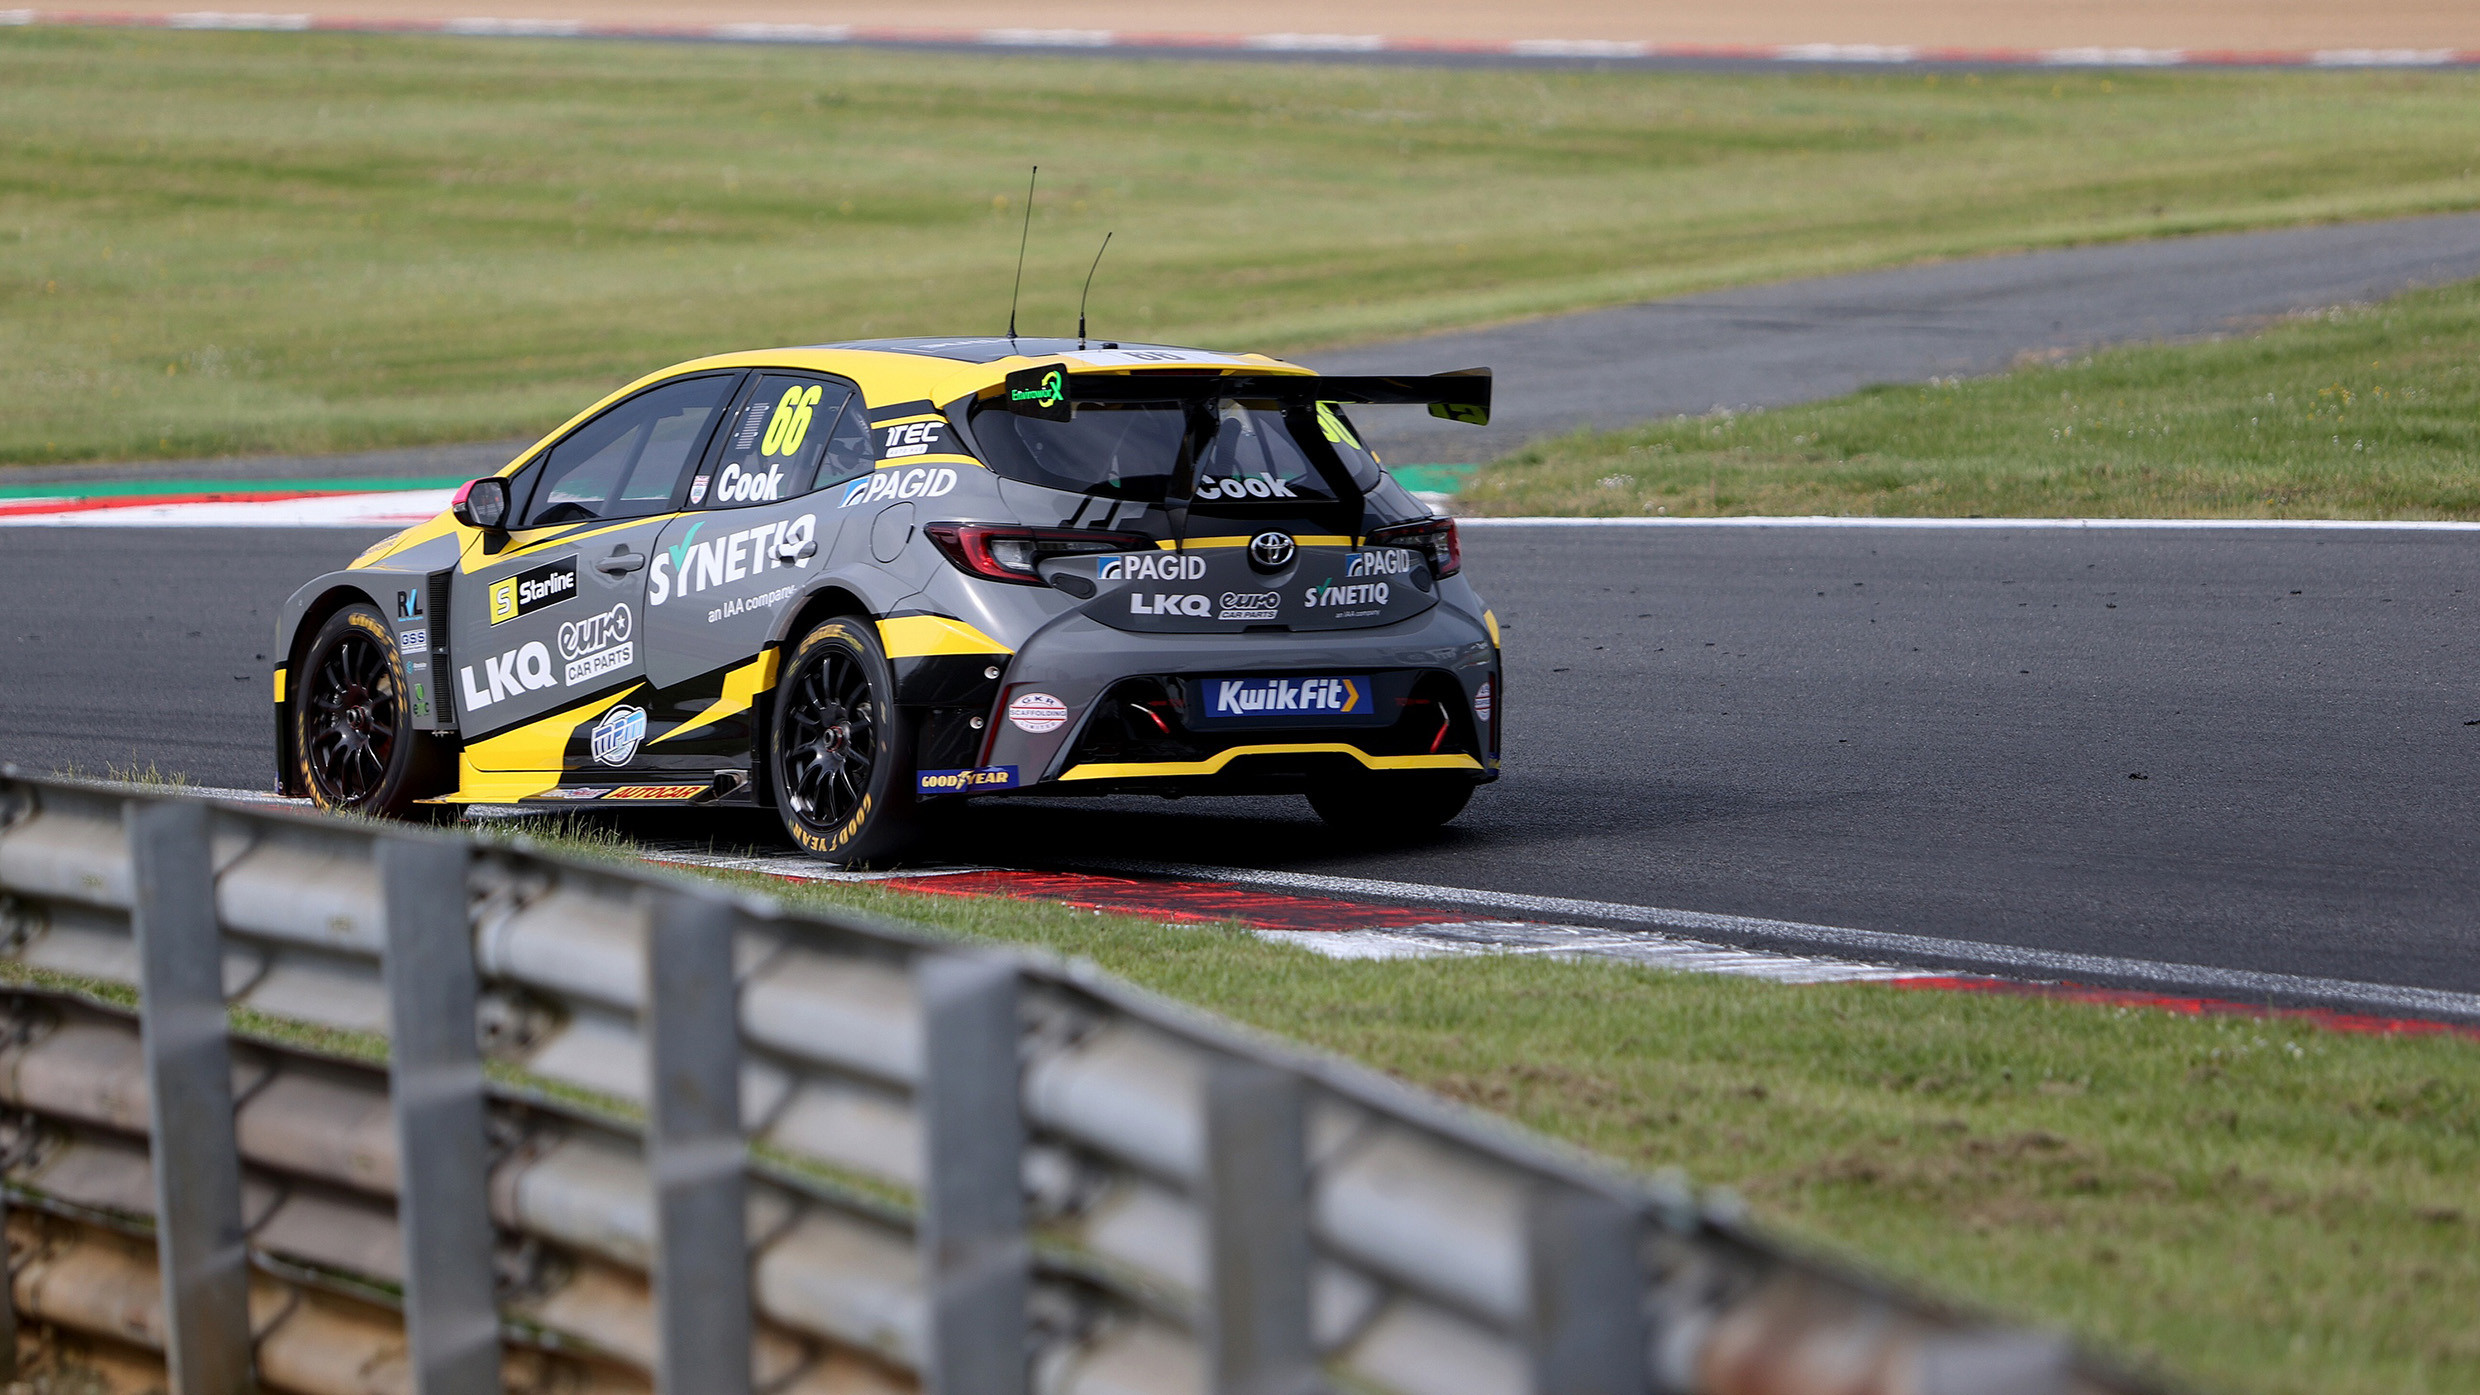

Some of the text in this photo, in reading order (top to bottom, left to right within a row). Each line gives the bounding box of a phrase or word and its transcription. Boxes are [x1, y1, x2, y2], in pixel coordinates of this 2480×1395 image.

[761, 385, 823, 457] 66
[717, 463, 784, 502] Cook
[862, 468, 958, 504] PAGID
[1197, 472, 1298, 500] Cook
[649, 513, 817, 607] SYNETIQ
[1125, 555, 1206, 581] PAGID
[1364, 549, 1410, 576] PAGID
[519, 572, 575, 605] Starline
[1219, 591, 1281, 609] euro
[1304, 577, 1390, 608] SYNETIQ
[708, 584, 798, 624] an IAA company
[1130, 593, 1212, 618] LKQ
[1244, 610, 1274, 618] PARTS
[401, 631, 425, 645] GSS
[557, 603, 632, 661] euro
[460, 641, 558, 712] LKQ
[568, 647, 630, 681] CAR PARTS
[1009, 709, 1067, 717] SCAFFOLDING
[1021, 696, 1055, 705] GKR
[611, 785, 701, 799] AUTOCAR
[921, 770, 1009, 790] GOODYEAR
